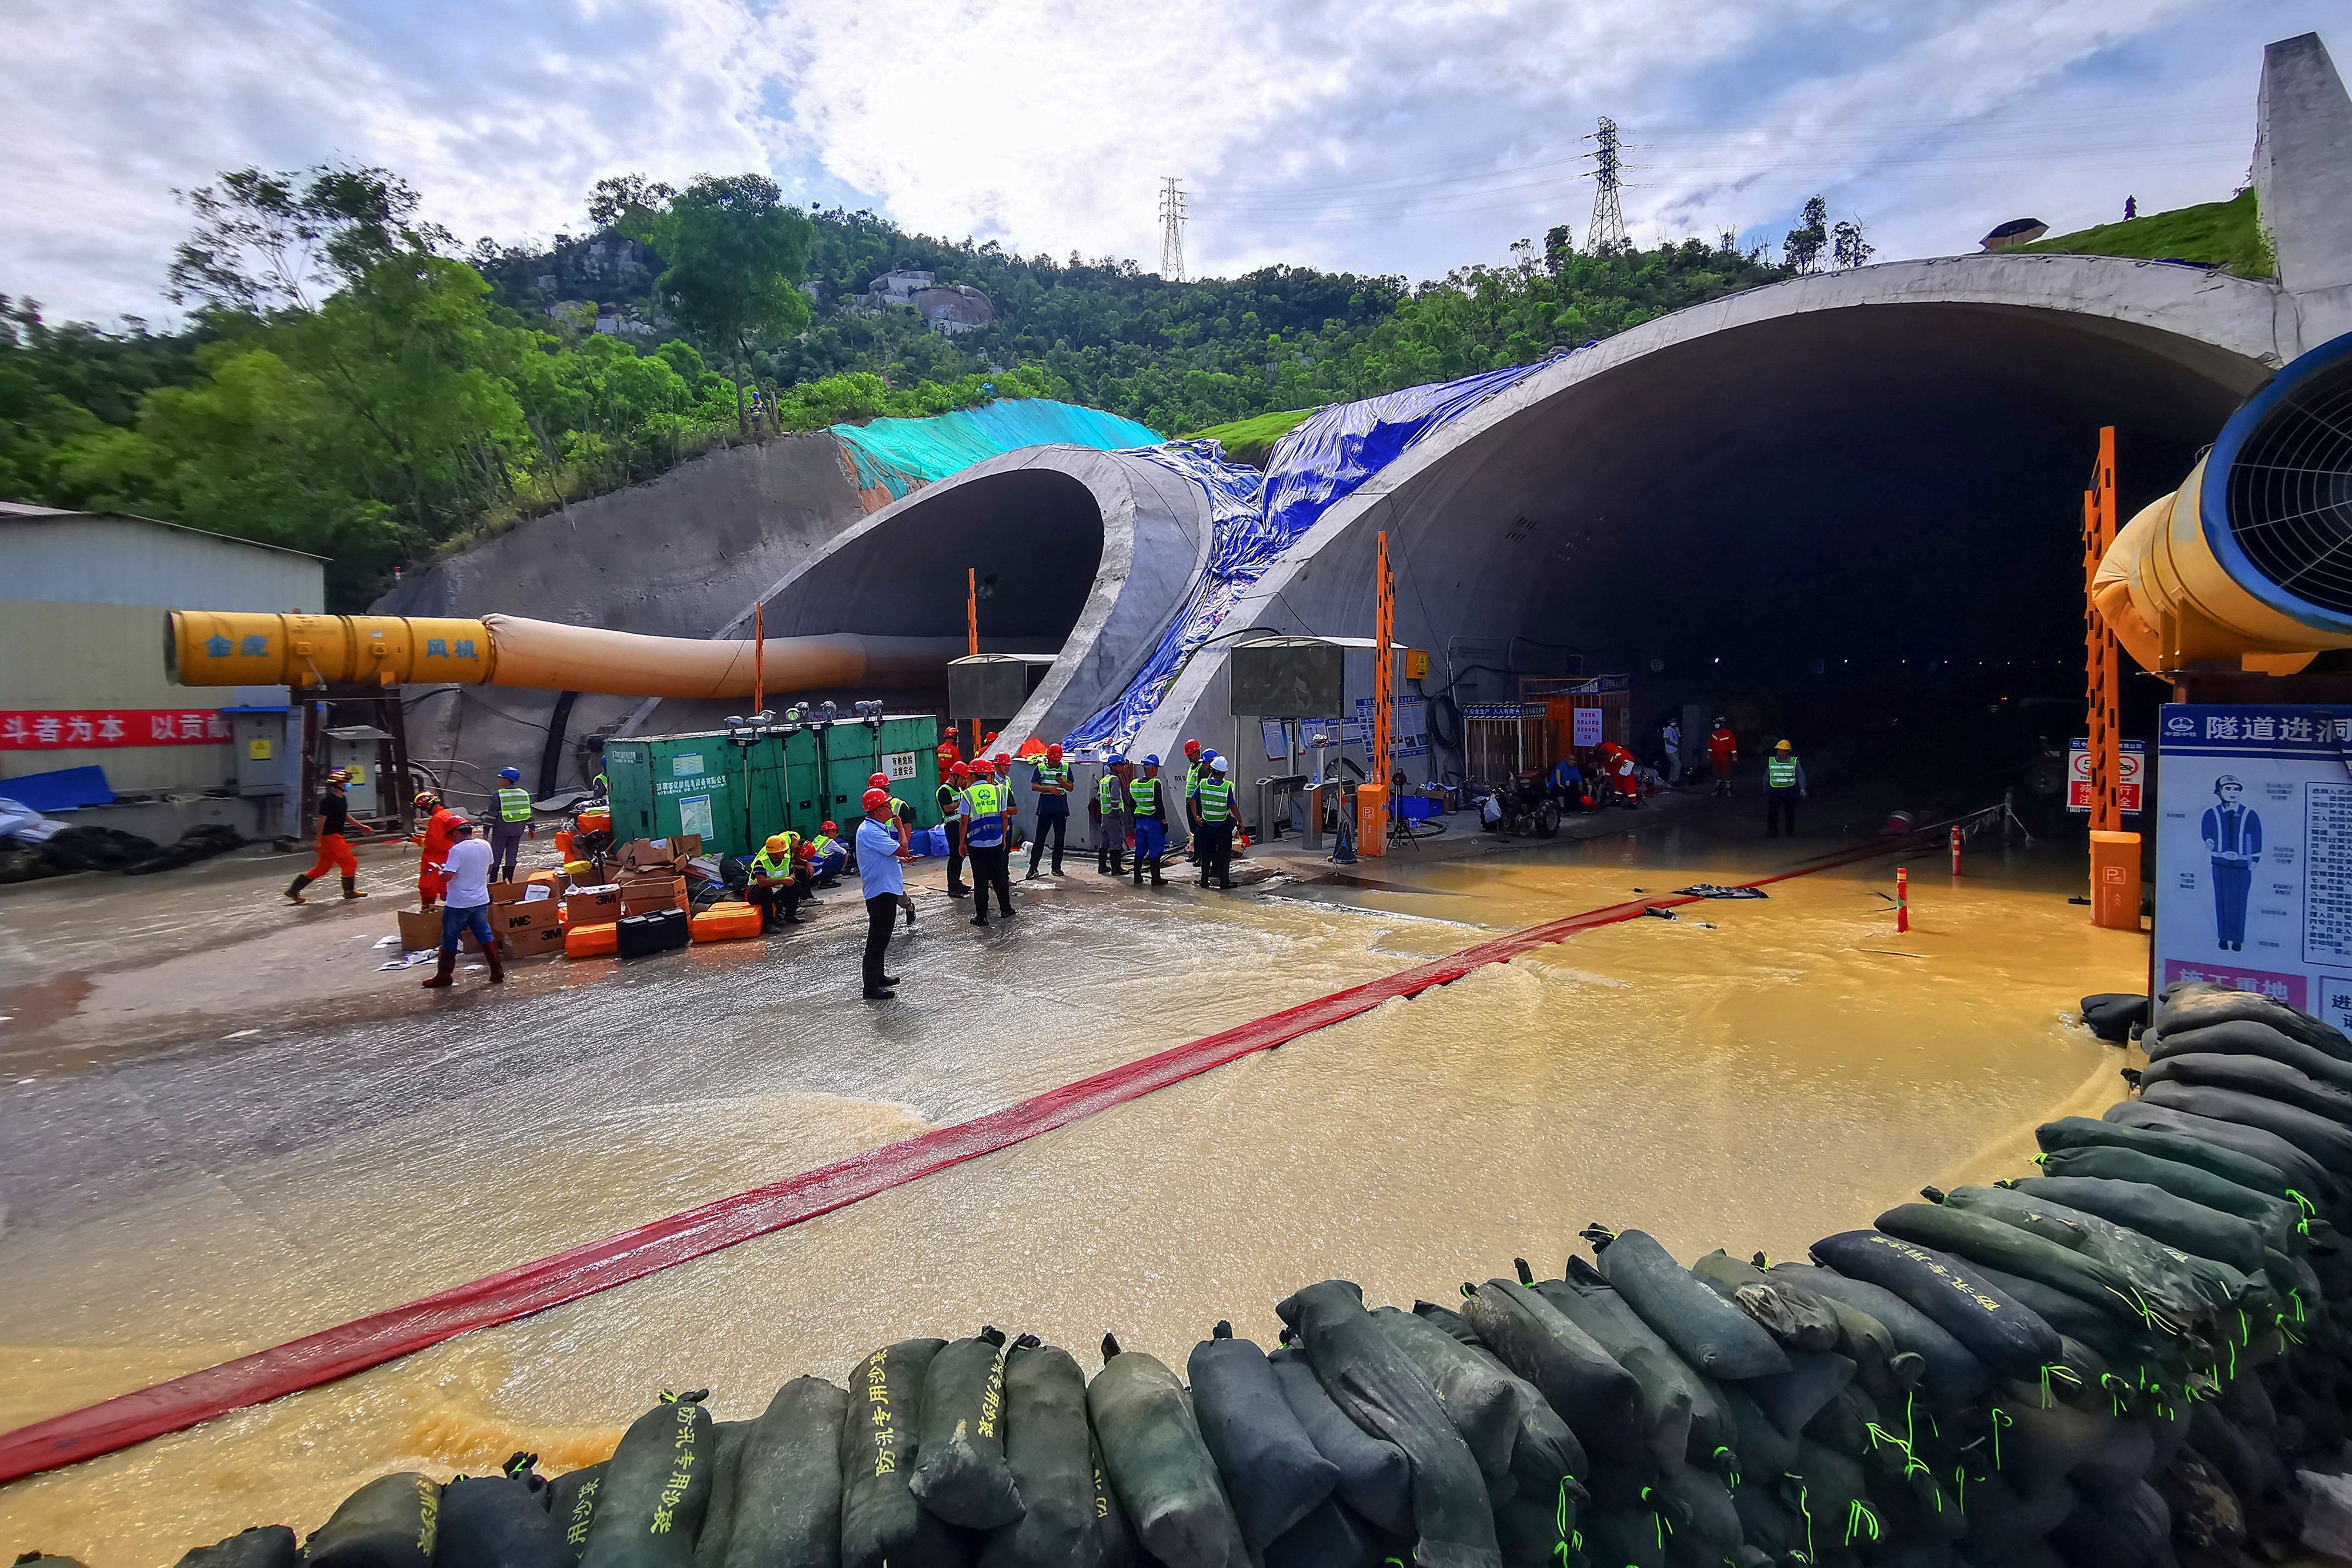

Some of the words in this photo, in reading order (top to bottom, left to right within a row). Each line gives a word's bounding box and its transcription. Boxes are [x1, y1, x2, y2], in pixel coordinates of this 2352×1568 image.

[427, 638, 479, 660] 风机
[1, 714, 126, 744] 斗者为本
[892, 755, 913, 766] 有电危险
[893, 766, 914, 777] 注意安全
[595, 894, 617, 906] 3M
[540, 928, 562, 941] 3M
[867, 1349, 897, 1477] 防汛专用沙袋
[650, 1406, 697, 1534] 防汛专用沙袋
